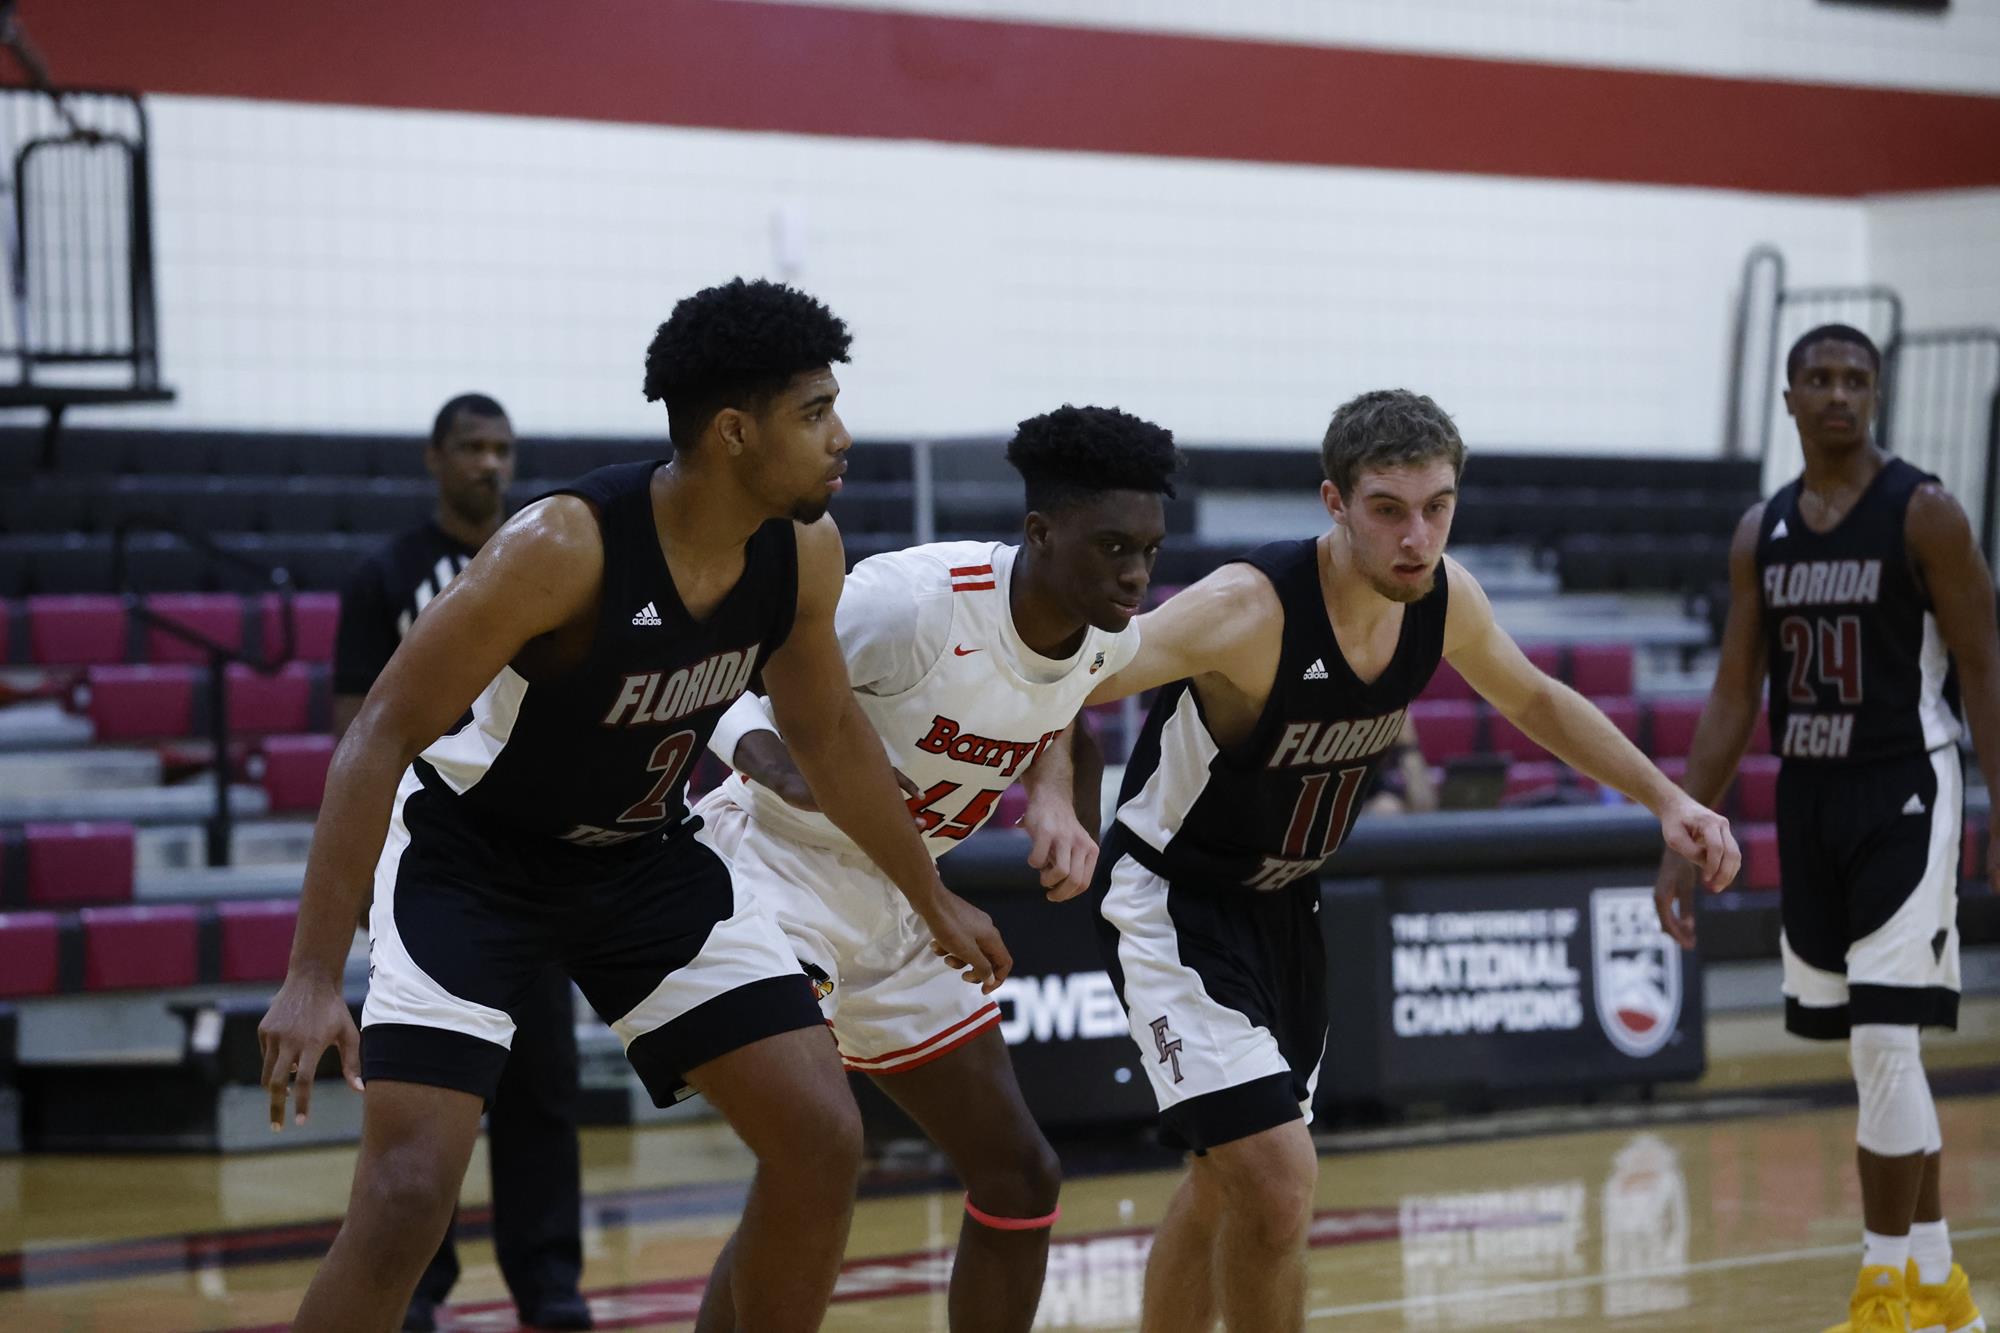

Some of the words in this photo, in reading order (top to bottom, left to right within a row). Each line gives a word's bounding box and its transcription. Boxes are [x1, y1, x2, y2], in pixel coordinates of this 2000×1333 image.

[1764, 559, 1882, 607] FLORIDA
[632, 617, 662, 626] adidas
[602, 641, 761, 726] FLORIDA
[1303, 671, 1329, 680] adidas
[1781, 616, 1863, 704] 24
[915, 714, 1038, 777] Barry
[1782, 713, 1855, 758] TECH
[615, 729, 697, 823] 2
[1281, 765, 1368, 859] 11
[1393, 939, 1581, 991] NATIONAL
[994, 971, 1138, 1045] OWE
[1393, 989, 1584, 1037] CHAMPIONS
